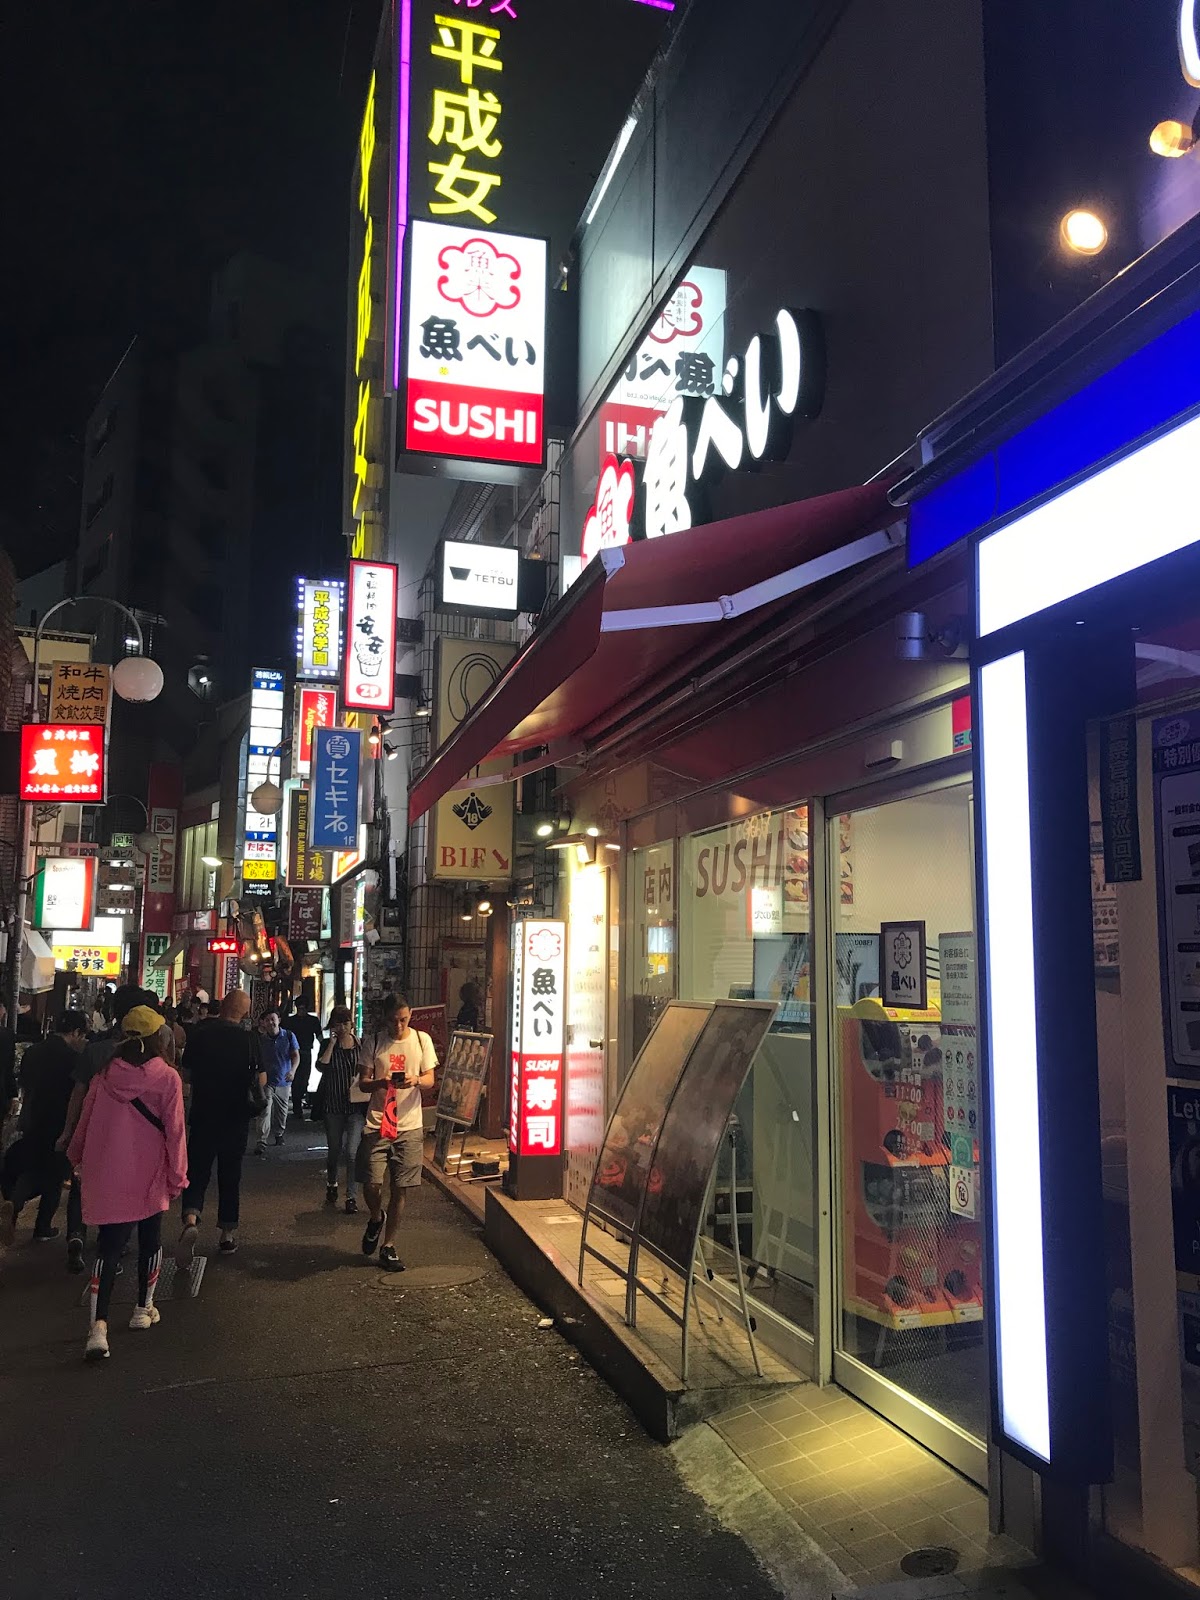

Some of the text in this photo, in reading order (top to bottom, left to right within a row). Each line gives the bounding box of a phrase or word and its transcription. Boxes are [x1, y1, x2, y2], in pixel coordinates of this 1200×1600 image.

[428, 14, 503, 225] 平成女
[418, 315, 538, 367] 魚べい
[413, 398, 537, 445] SUSHI
[474, 573, 514, 586] TETSU
[312, 590, 330, 667] 平成女学園
[58, 665, 105, 682] 和牛
[56, 684, 104, 701] 焼肉
[323, 736, 350, 834] 質 セキネ
[298, 805, 307, 831] YELLOW
[466, 811, 479, 825] 18
[297, 831, 306, 855] BLANK
[343, 835, 356, 847] 1F
[150, 850, 159, 885] IBUYA
[158, 838, 174, 883] LABI
[296, 855, 305, 881] MARKET
[439, 845, 487, 870] B1F
[695, 829, 784, 899] SUSHI
[643, 862, 672, 906] 店内
[293, 891, 320, 934] たばこ
[73, 948, 101, 957] ビストロ
[530, 966, 558, 1038] 魚べい
[389, 1054, 407, 1063] BAD
[389, 1062, 405, 1071] ASS
[525, 1059, 560, 1072] SUSHI
[895, 1084, 922, 1103] 11:00
[525, 1076, 557, 1150] 寿司
